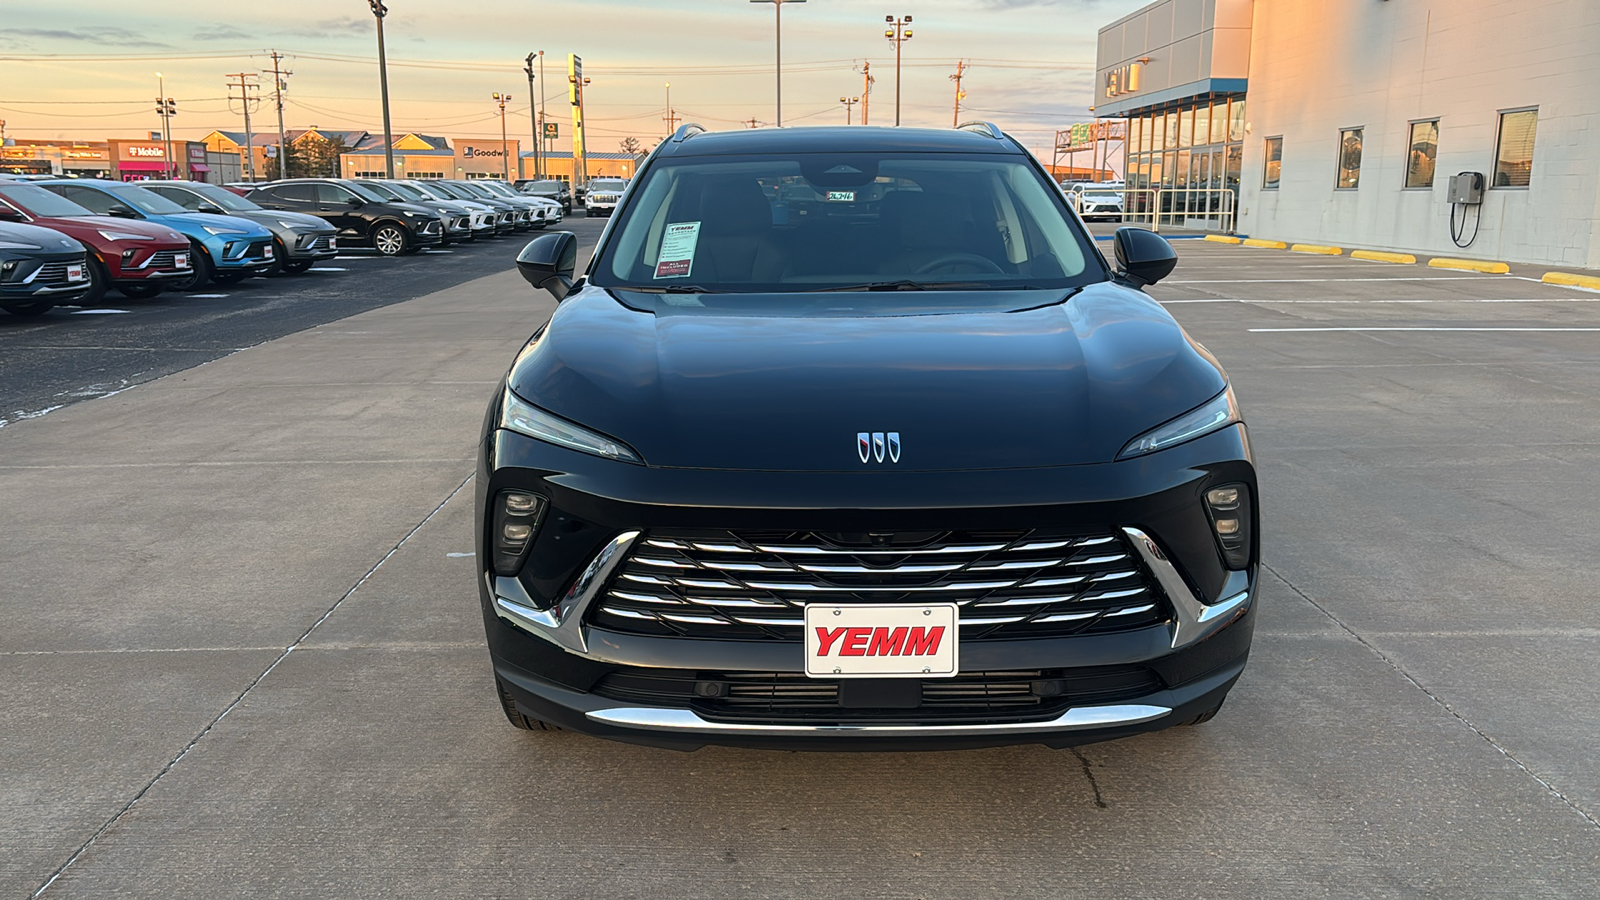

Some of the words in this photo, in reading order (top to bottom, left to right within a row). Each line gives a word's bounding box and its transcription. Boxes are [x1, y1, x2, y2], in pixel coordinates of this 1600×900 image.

[137, 147, 164, 157] Mobile
[474, 149, 509, 157] Goodwll
[815, 626, 946, 657] YEMM
